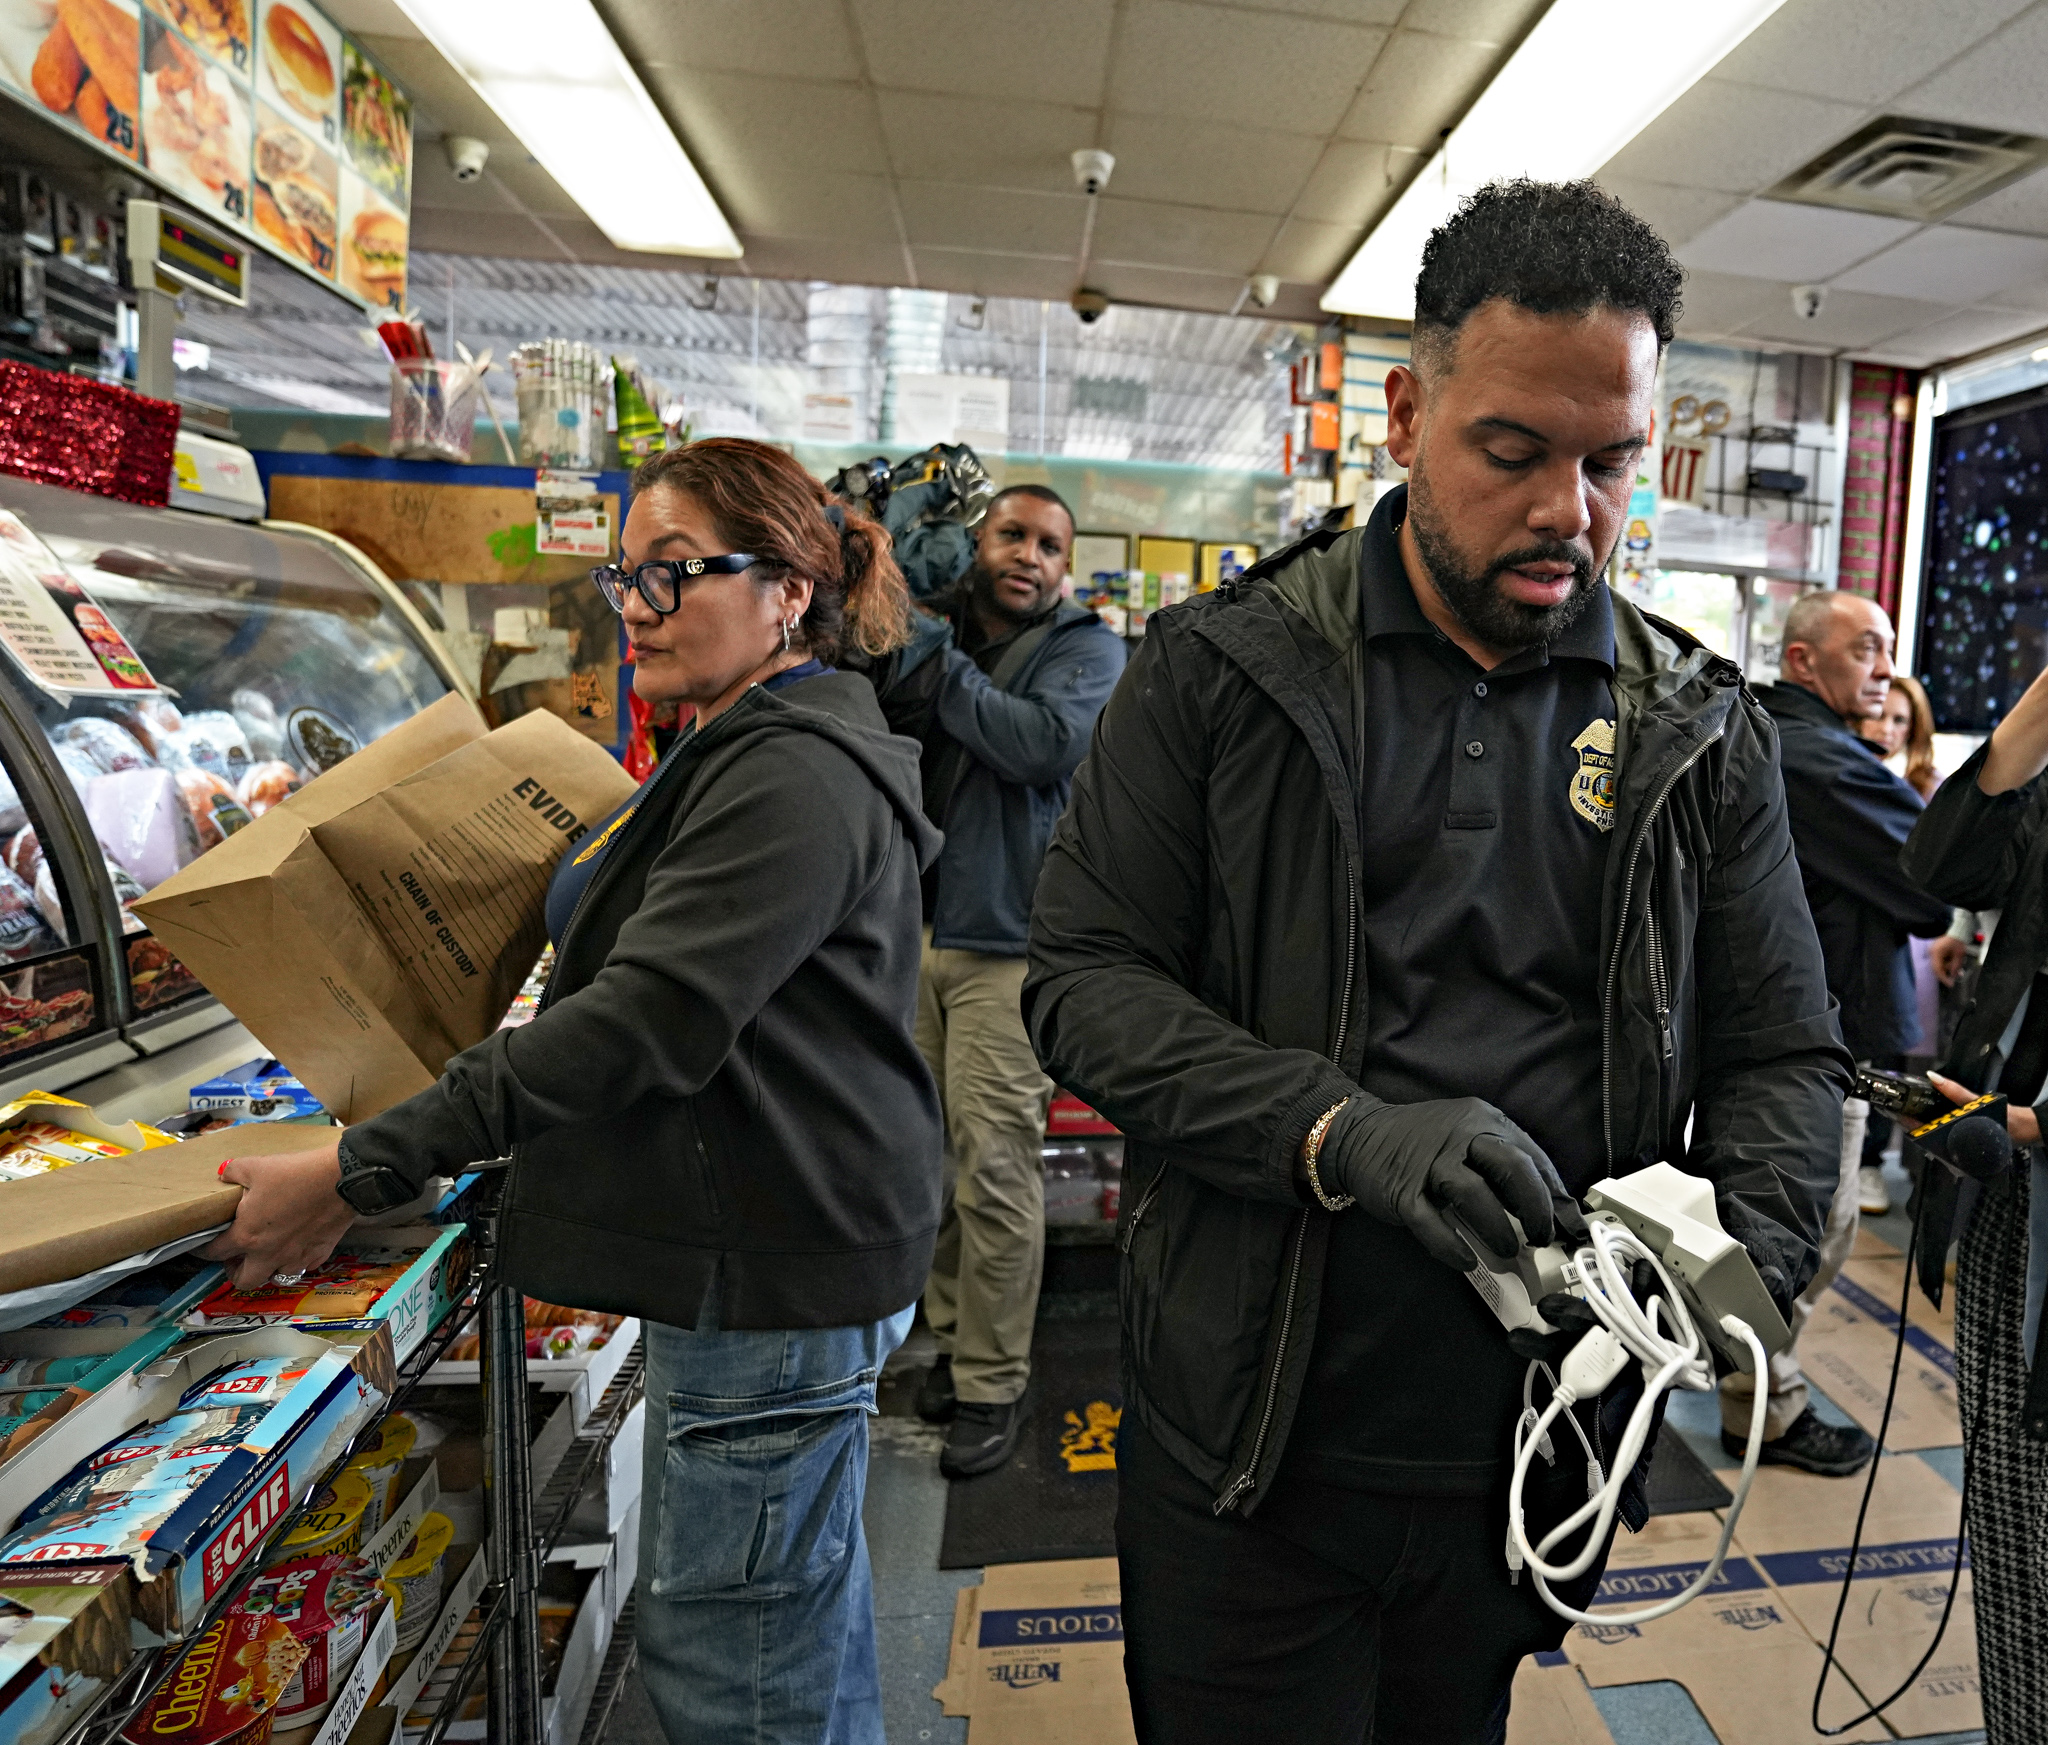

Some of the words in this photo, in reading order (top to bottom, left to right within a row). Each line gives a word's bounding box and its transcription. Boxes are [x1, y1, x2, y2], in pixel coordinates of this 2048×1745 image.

[106, 102, 134, 149] 25
[1662, 446, 1703, 501] XIT
[1584, 753, 1599, 764] DEPT
[1599, 755, 1607, 766] OF
[512, 777, 590, 846] EVIDE
[1578, 796, 1614, 820] INVESTIG
[398, 871, 433, 912] CHAIN
[425, 909, 443, 928] OF
[435, 925, 479, 979] CUSTODY
[352, 1319, 375, 1330] 12
[388, 1278, 424, 1338] ONE
[209, 1503, 233, 1528] PEANUT
[233, 1479, 255, 1504] BUTTER
[254, 1453, 277, 1480] BANANA
[211, 1542, 223, 1587] BAR
[224, 1472, 285, 1565] CLIF
[3, 1573, 30, 1581] BARS
[32, 1571, 76, 1580] ENERGY
[71, 1569, 105, 1585] 12
[244, 1576, 284, 1615] OOT
[273, 1569, 318, 1623] LOOPS
[1597, 1569, 1731, 1598] DELICIO
[417, 1607, 458, 1683] Cheerios
[1016, 1612, 1122, 1637] ICIOUS
[152, 1619, 226, 1733] Cheerios
[333, 1687, 354, 1727] Honey
[352, 1662, 365, 1689] Nut
